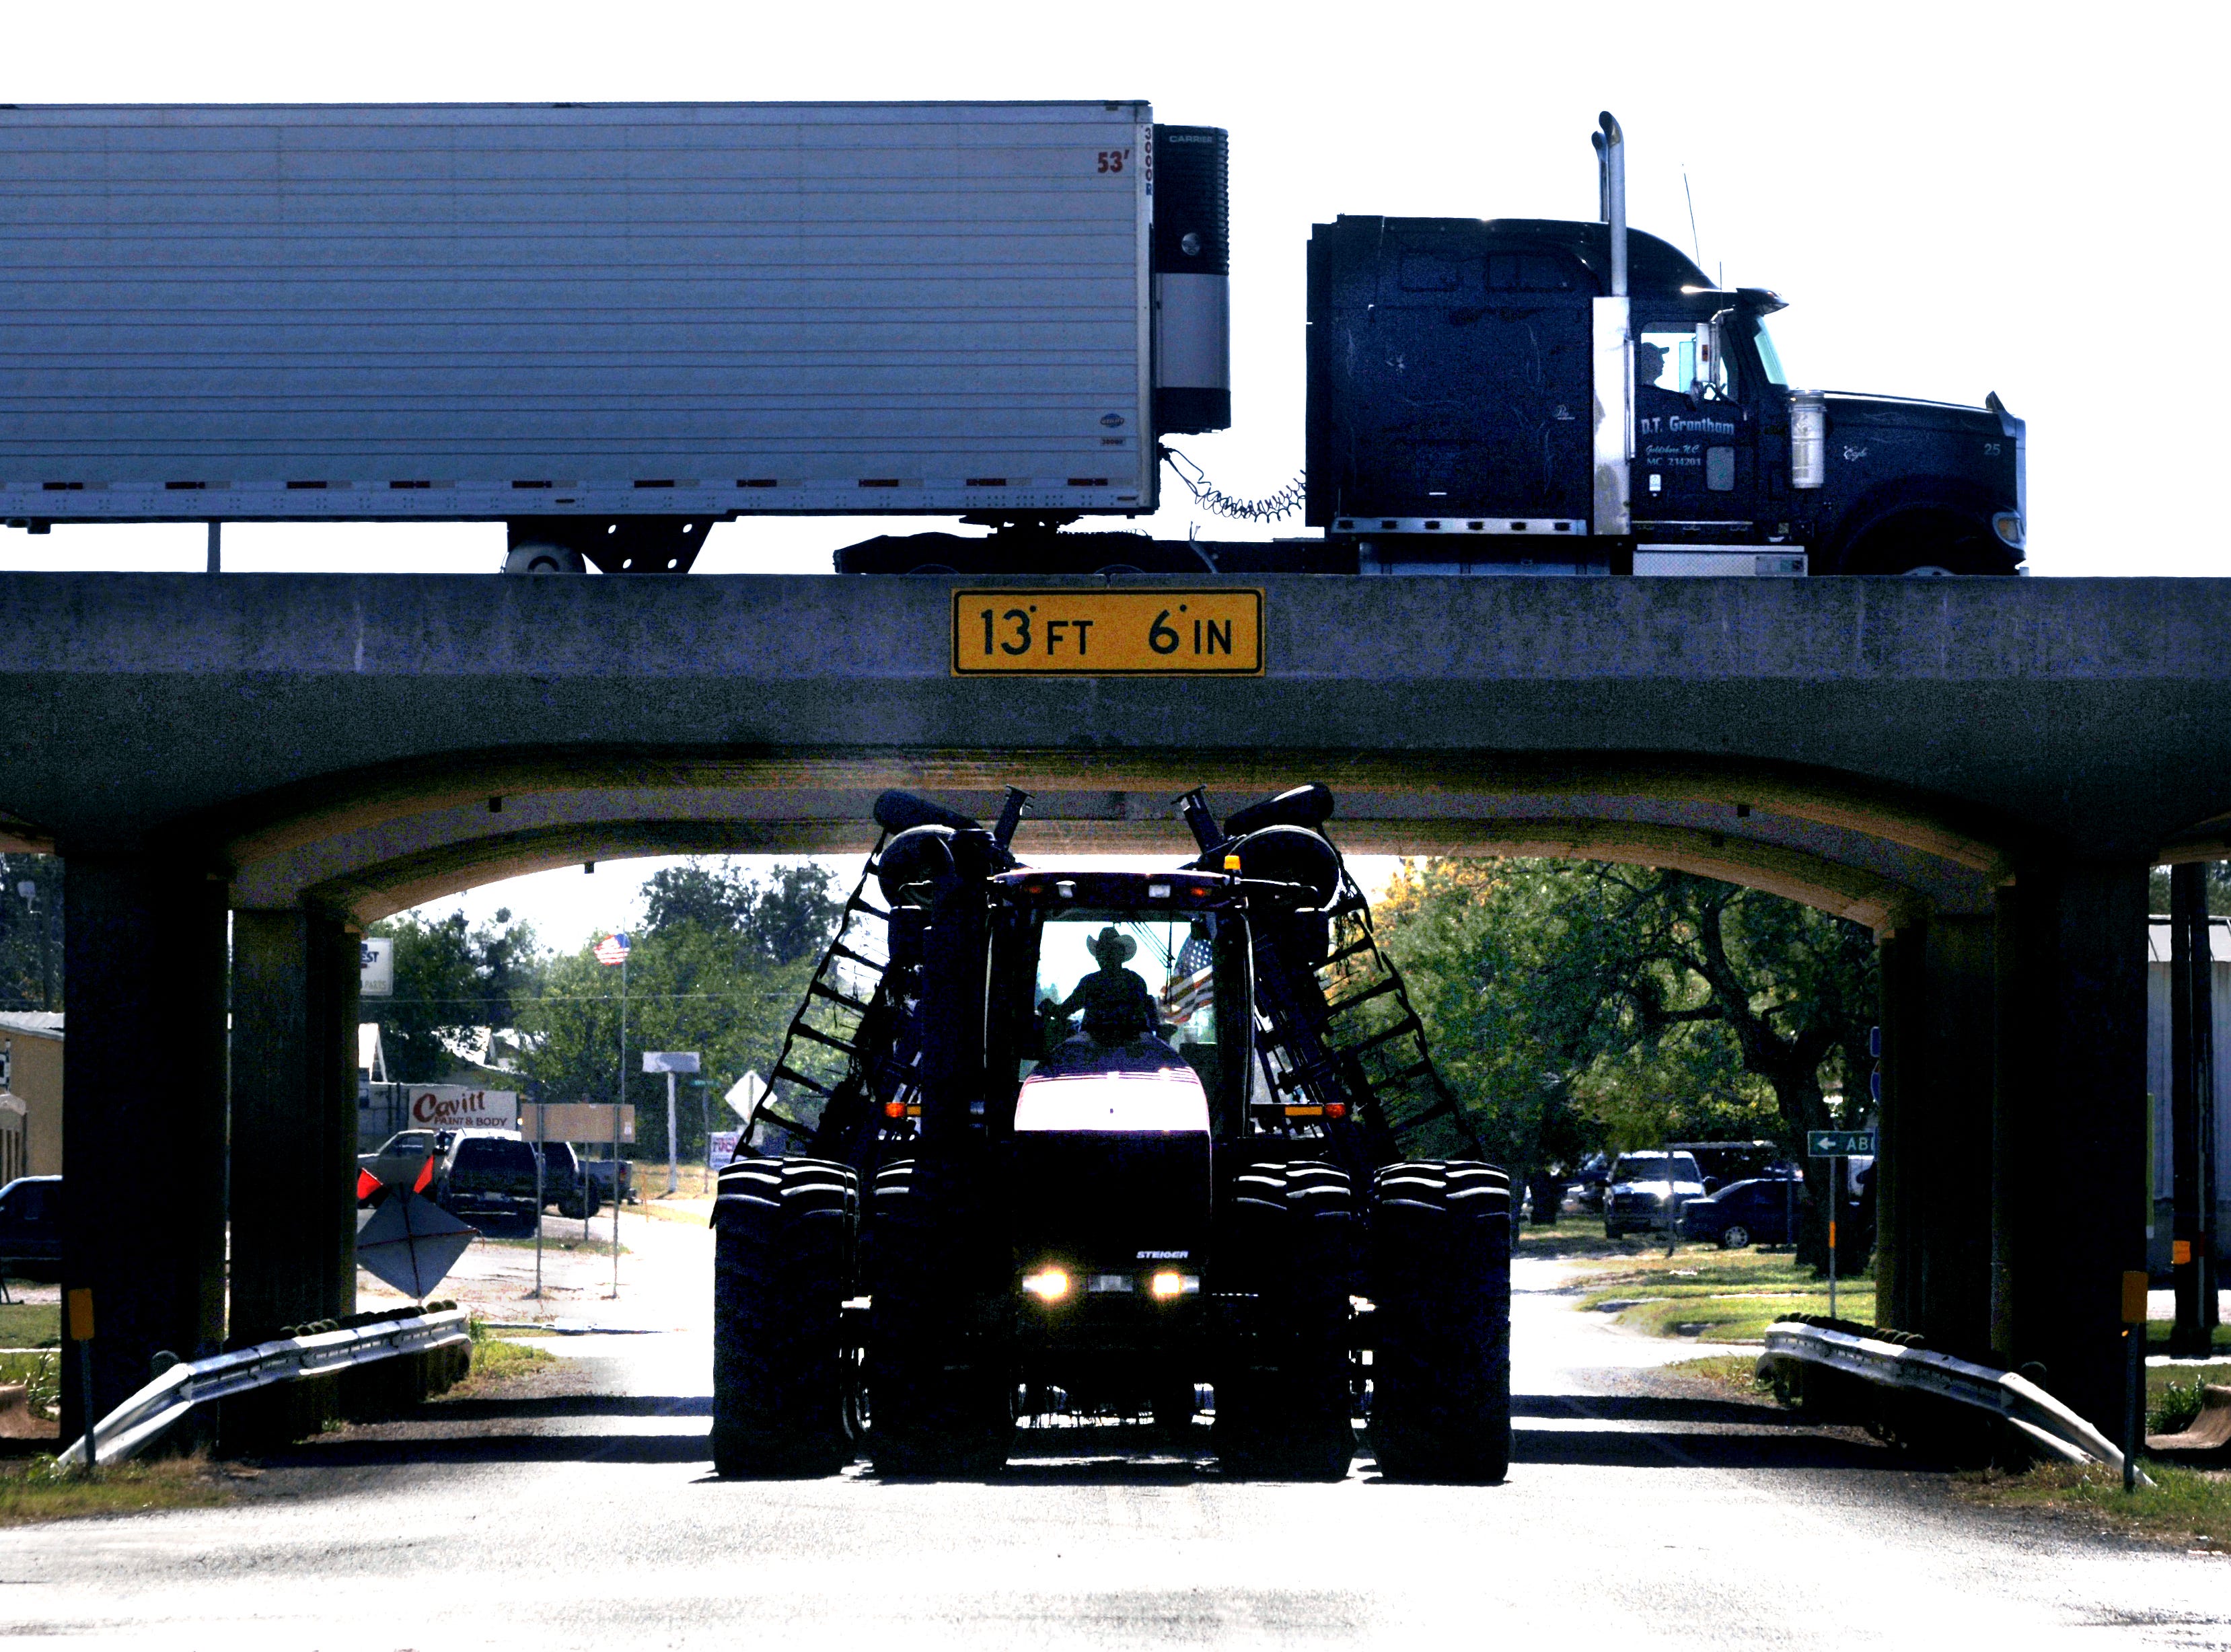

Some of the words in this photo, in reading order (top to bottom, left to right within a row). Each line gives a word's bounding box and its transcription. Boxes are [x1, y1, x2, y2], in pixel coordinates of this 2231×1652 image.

[1169, 135, 1212, 143] CARRIER
[1097, 149, 1130, 174] 53'
[1670, 415, 1734, 435] Grantham
[1985, 443, 2001, 456] 25
[1647, 457, 1663, 466] MC
[981, 608, 1031, 655] 13
[1048, 620, 1094, 655] FT
[1148, 609, 1179, 654] 6
[1194, 619, 1232, 654] IN
[413, 1091, 485, 1123] Cavitt
[434, 1117, 464, 1125] PAINT
[466, 1117, 474, 1126] &
[476, 1117, 508, 1127] BODY
